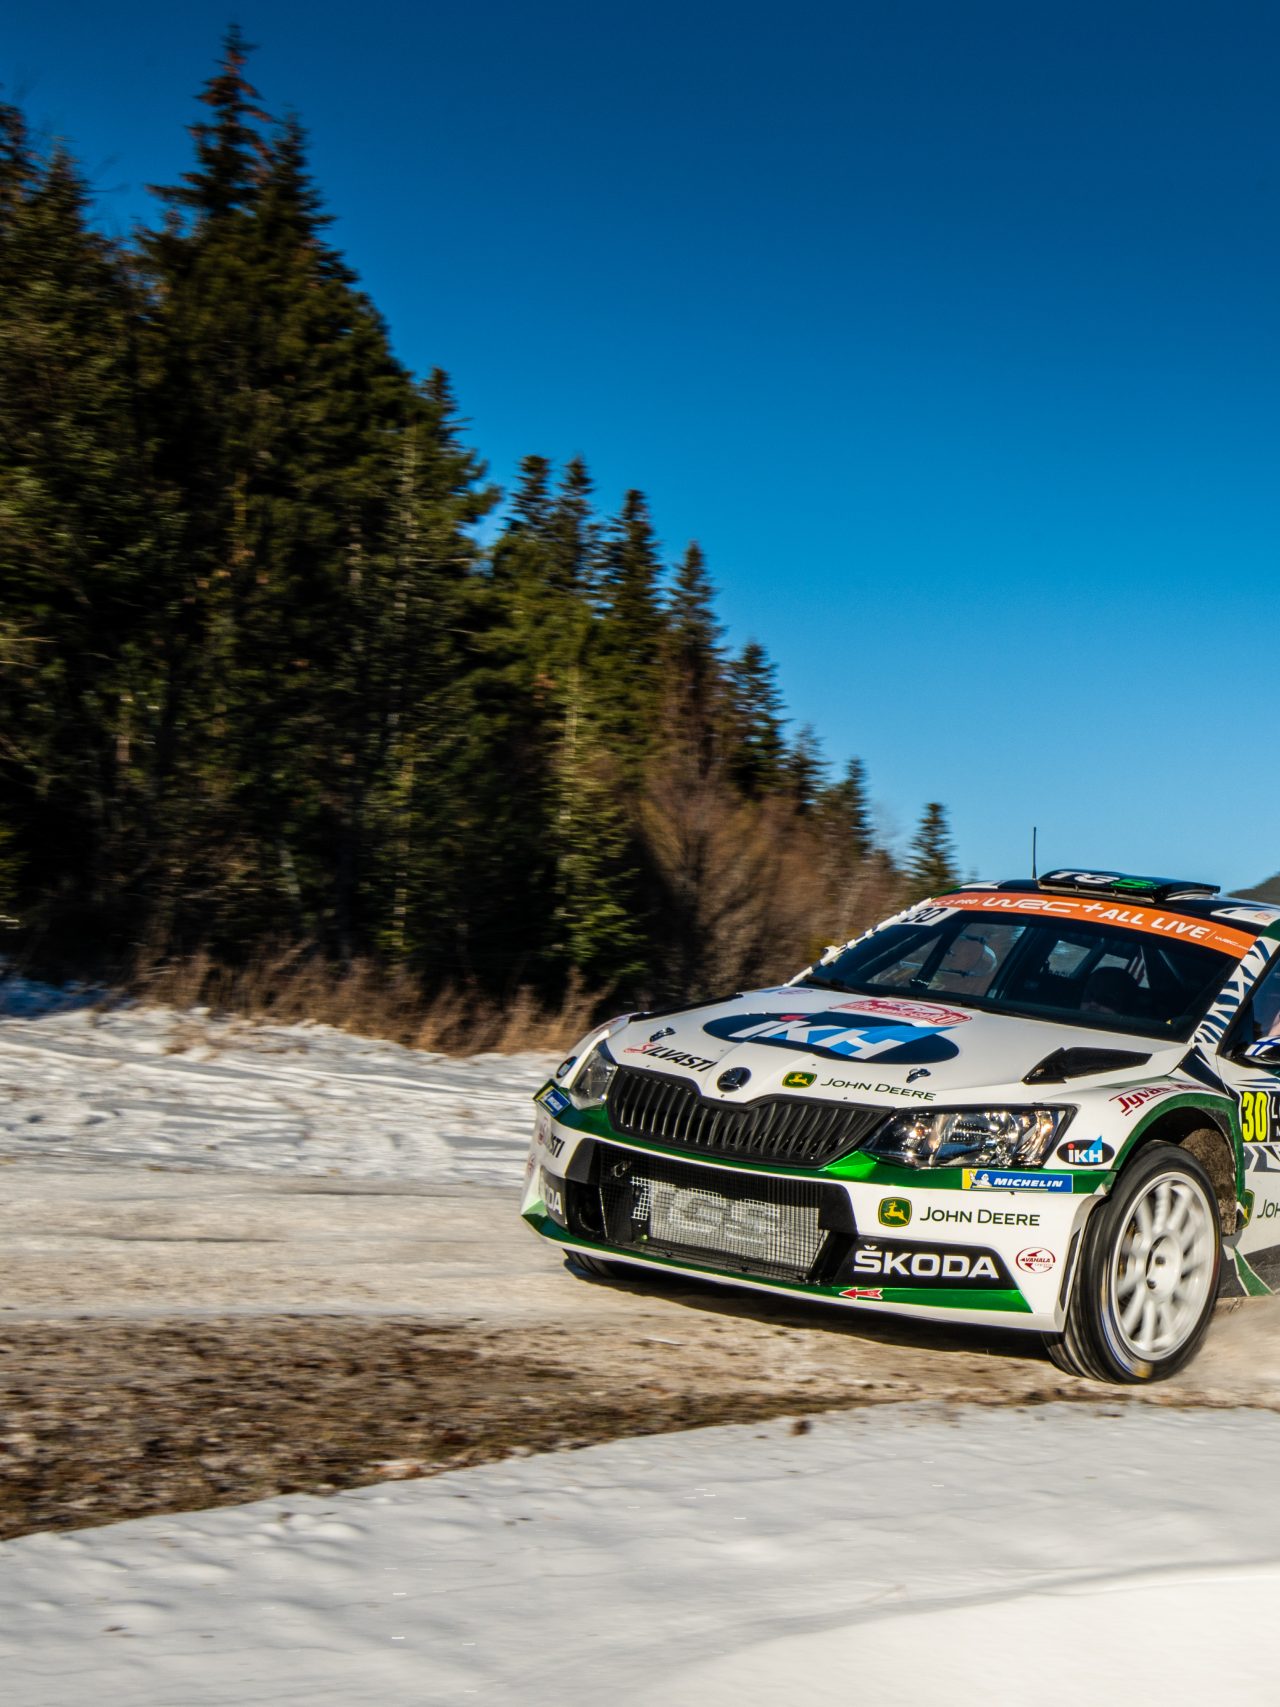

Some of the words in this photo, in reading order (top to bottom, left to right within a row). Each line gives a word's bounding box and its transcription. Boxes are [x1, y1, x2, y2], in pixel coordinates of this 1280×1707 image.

[1050, 871, 1155, 889] TGS
[1097, 908, 1144, 925] ALL
[1150, 917, 1210, 939] LIVE
[820, 1078, 871, 1091] JOHN
[874, 1083, 937, 1101] DEERE
[1242, 1091, 1268, 1142] 30
[993, 1177, 1064, 1188] MICHELIN
[919, 1206, 972, 1223] JOHN
[977, 1209, 1041, 1226] DEERE
[853, 1244, 1000, 1280] ŠKODA
